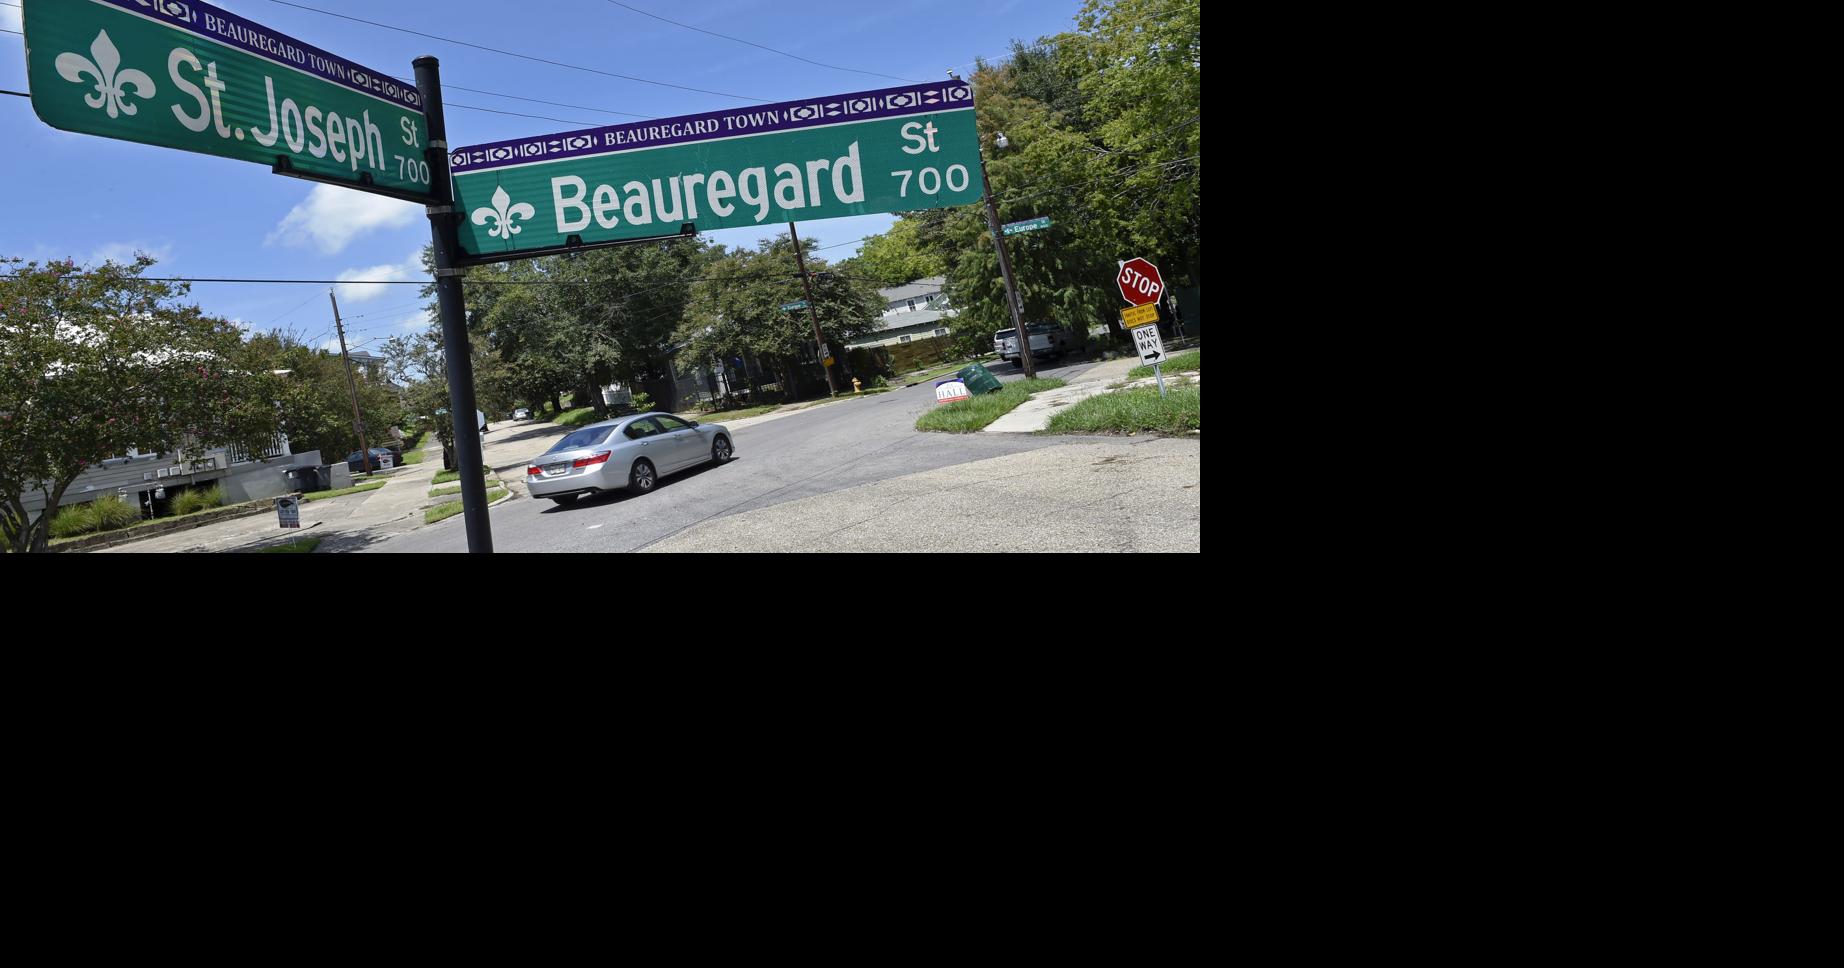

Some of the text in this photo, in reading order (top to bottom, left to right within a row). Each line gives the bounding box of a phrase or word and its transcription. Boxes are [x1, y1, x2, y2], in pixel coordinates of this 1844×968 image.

[204, 12, 346, 79] BEAUREGARD TOWN
[250, 76, 386, 172] Joseph
[400, 116, 420, 148] St
[604, 111, 779, 146] BEAUREGARD TOWN
[900, 120, 940, 154] St
[394, 154, 430, 185] 700
[891, 164, 969, 198] 700
[551, 140, 865, 234] Beauregard
[1014, 223, 1038, 233] Europe
[1121, 267, 1160, 297] STOP
[1136, 327, 1156, 341] ONE
[1138, 338, 1158, 351] WAY
[938, 388, 965, 399] HALL
